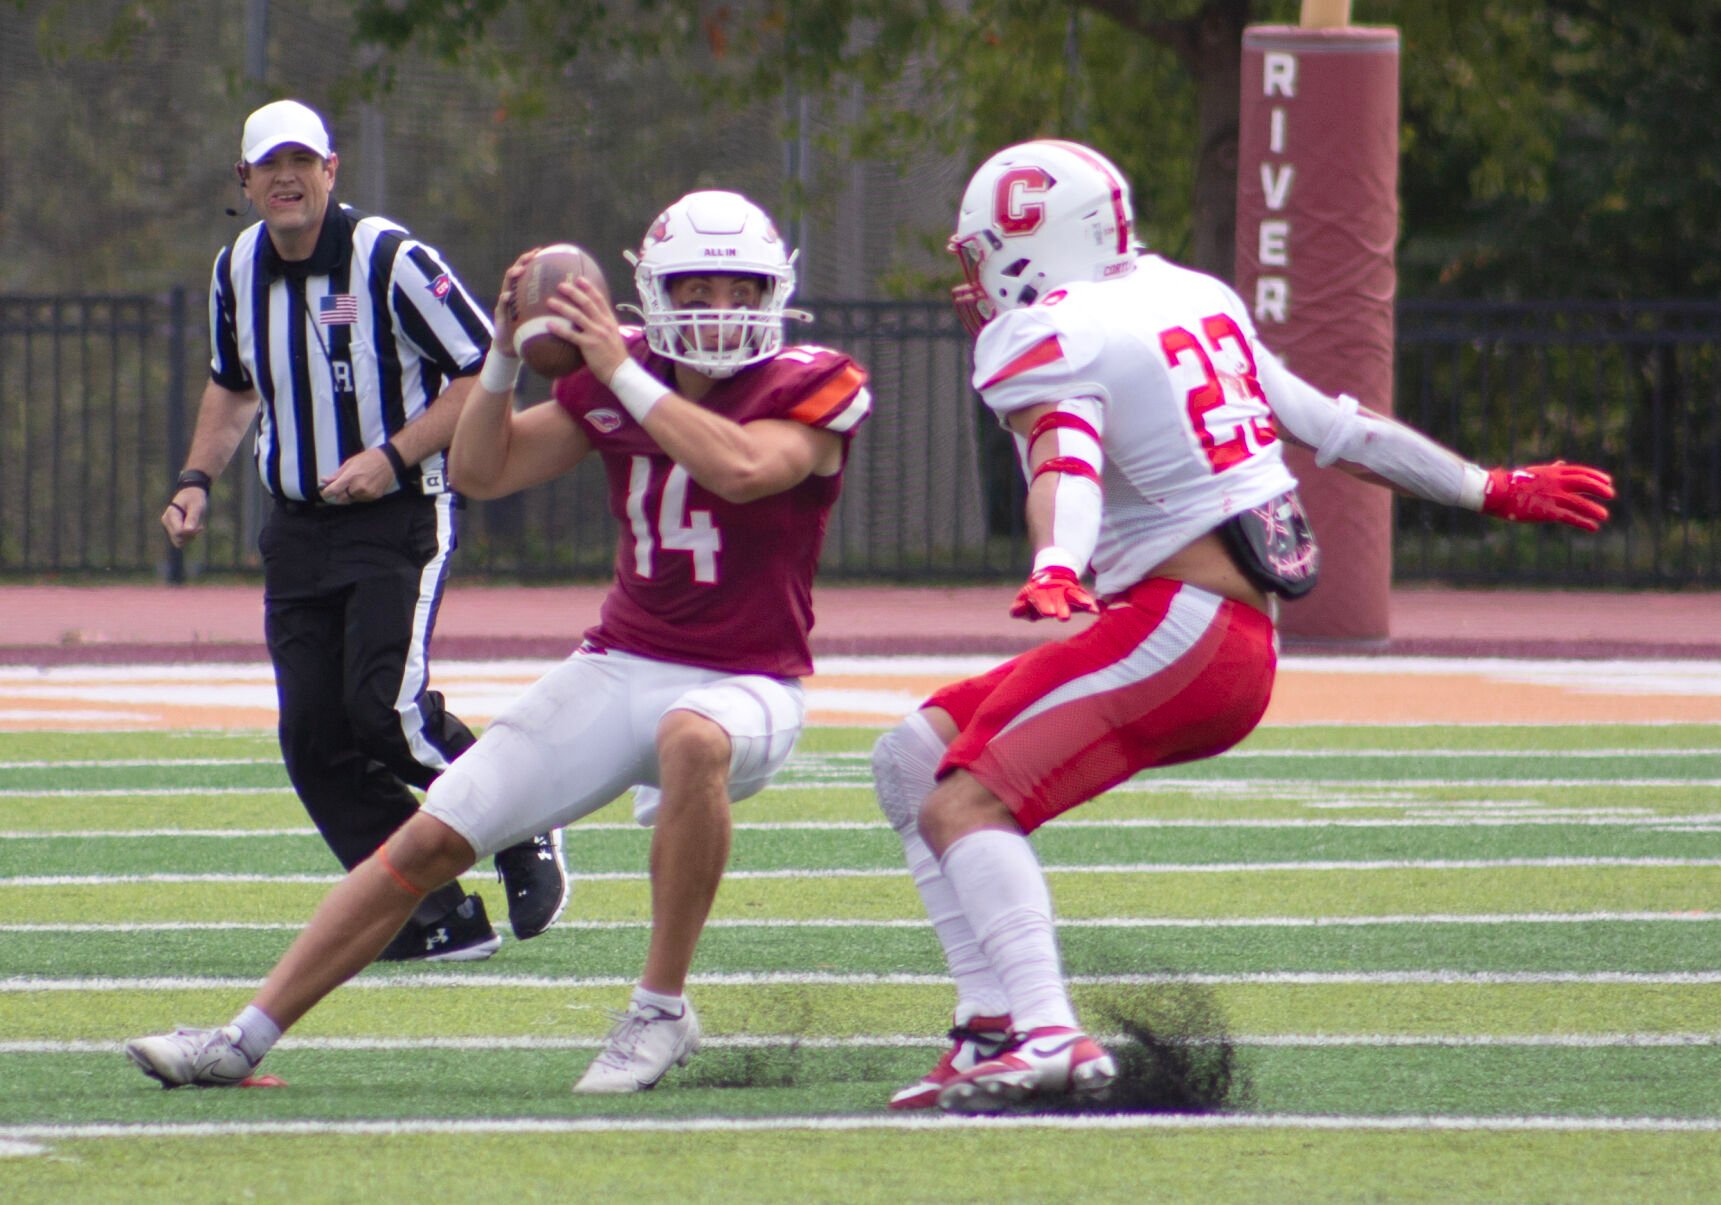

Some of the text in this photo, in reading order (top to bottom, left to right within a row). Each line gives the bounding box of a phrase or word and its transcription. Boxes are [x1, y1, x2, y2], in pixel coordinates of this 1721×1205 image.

[993, 166, 1053, 238] C
[1255, 51, 1296, 324] RIVER
[704, 248, 736, 256] ALL IN
[332, 361, 353, 392] R
[626, 455, 722, 584] 14
